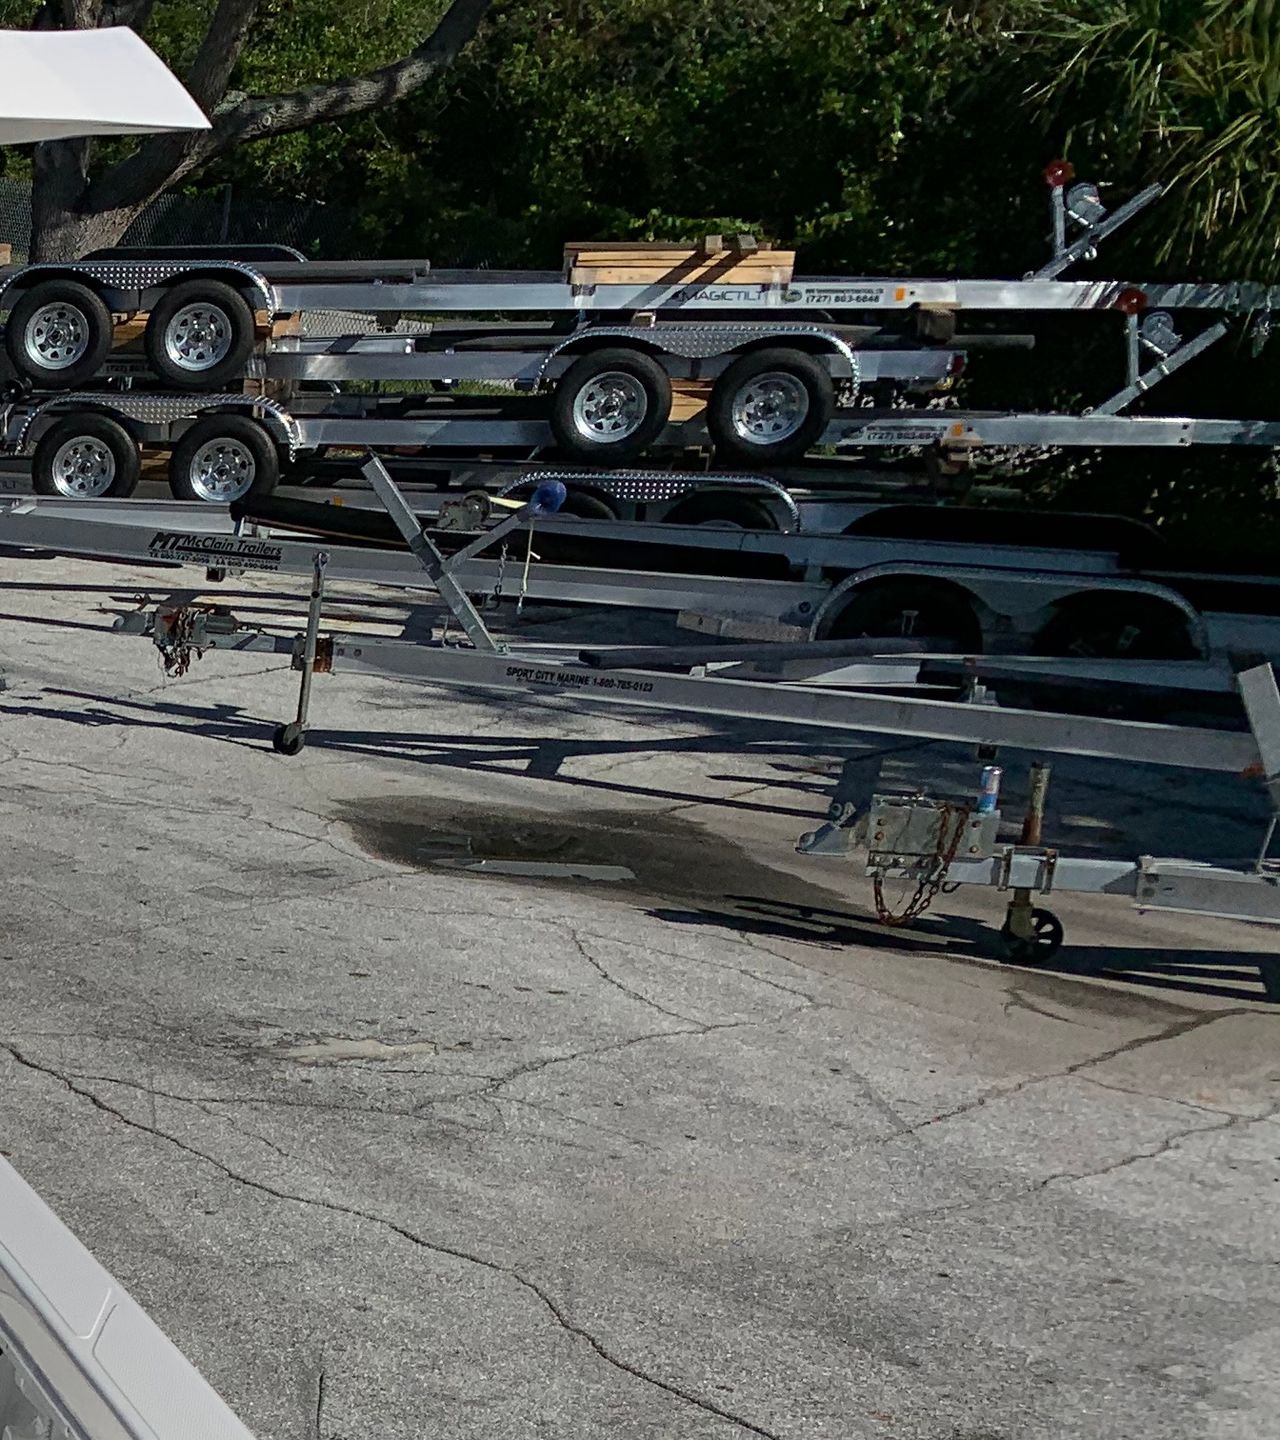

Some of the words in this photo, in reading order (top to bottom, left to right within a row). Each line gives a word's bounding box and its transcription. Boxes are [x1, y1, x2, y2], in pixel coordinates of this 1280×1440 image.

[182, 534, 235, 551] McClain
[236, 539, 283, 556] Trailers
[506, 666, 534, 679] SPORT
[535, 670, 555, 681] CITY
[556, 672, 590, 686] MARINE
